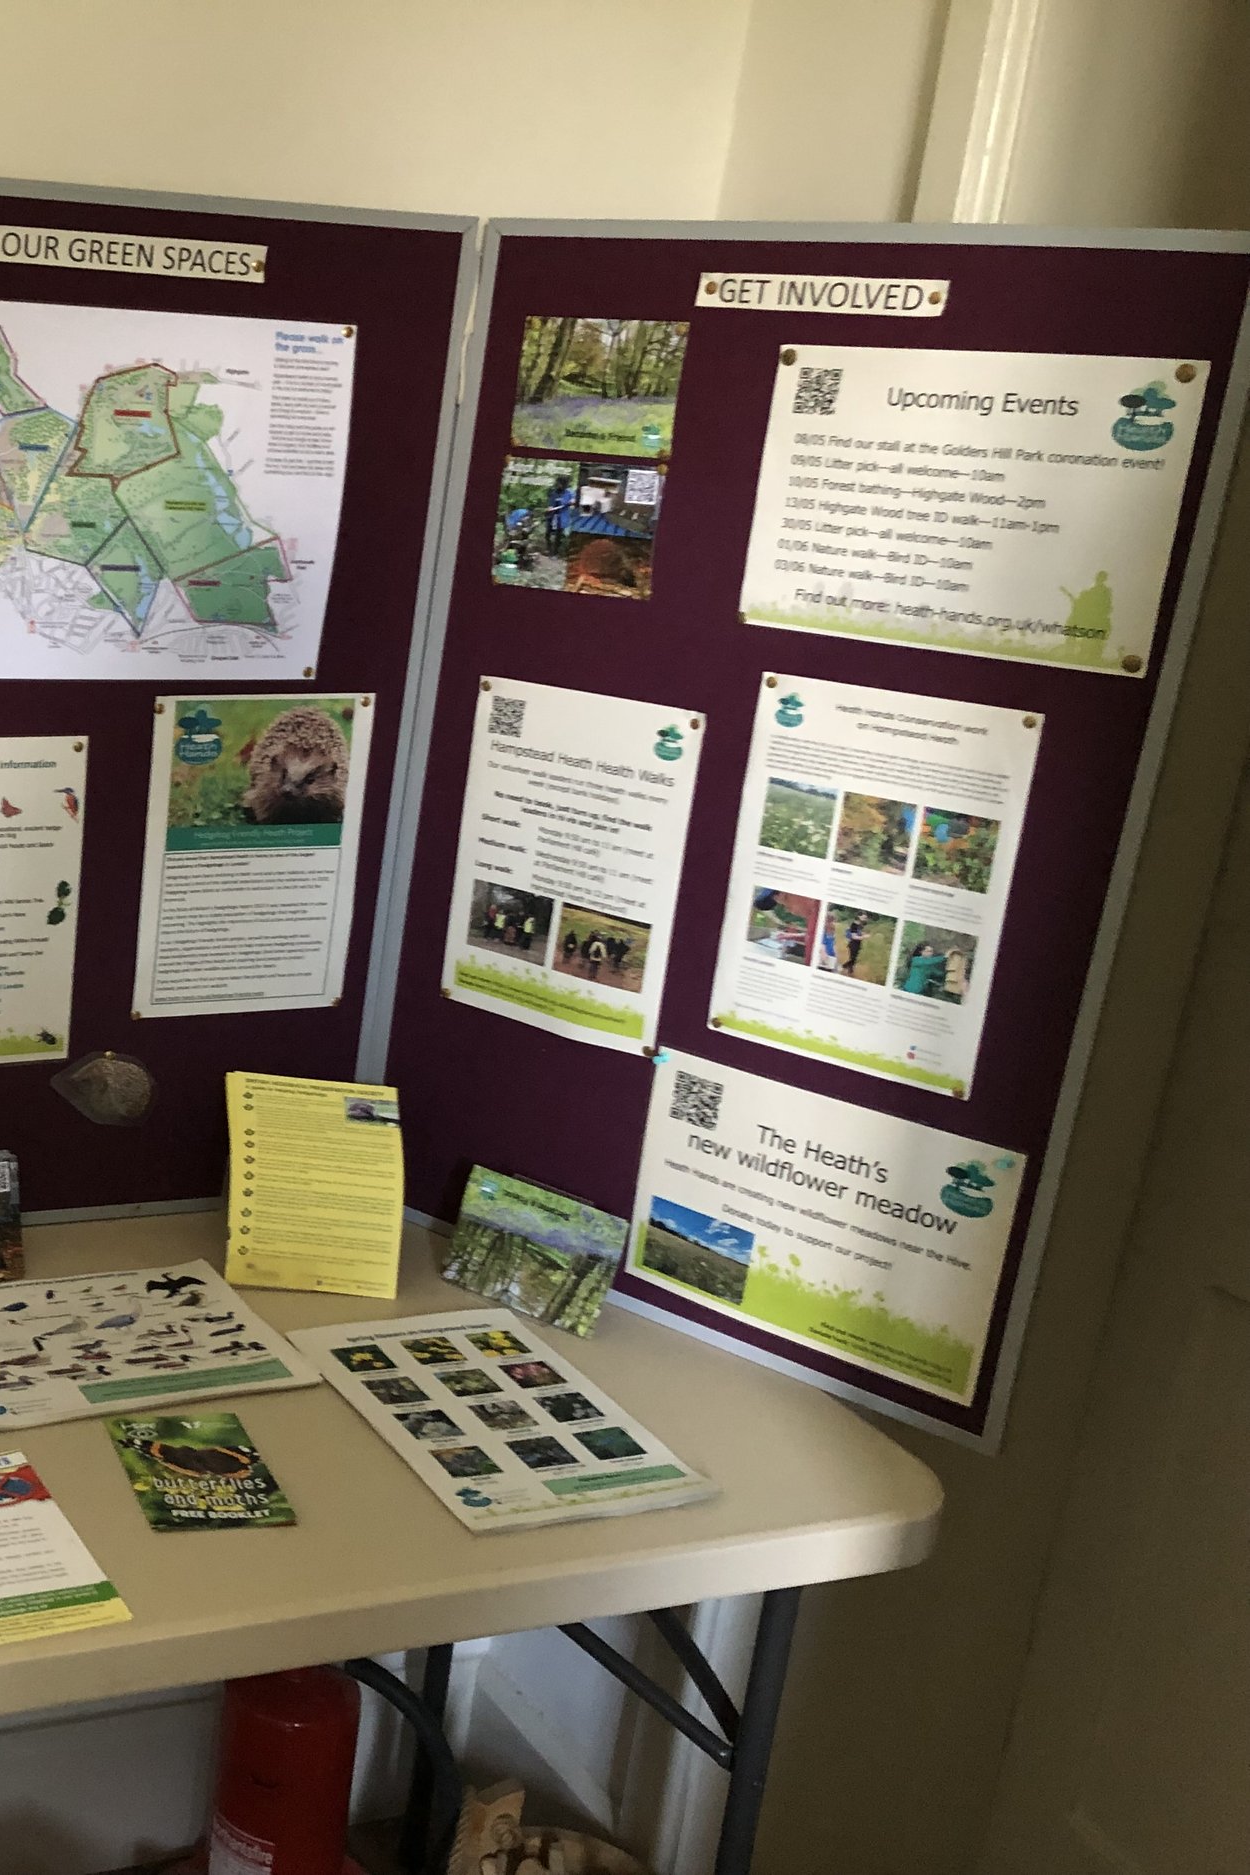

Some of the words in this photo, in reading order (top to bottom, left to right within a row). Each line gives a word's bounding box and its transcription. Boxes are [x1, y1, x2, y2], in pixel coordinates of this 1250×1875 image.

[1, 232, 60, 261] OUR
[68, 238, 154, 268] GREEN
[162, 246, 251, 276] SPACES
[718, 279, 771, 304] GET
[777, 280, 925, 311] INVOLVED
[887, 386, 994, 417] Upcoming
[1001, 392, 1080, 416] Events
[828, 435, 852, 448] Find
[854, 440, 875, 450] our
[903, 442, 917, 453] at
[918, 442, 939, 454] the
[1014, 448, 1044, 462] Park
[1047, 452, 1119, 467] coronation
[821, 478, 856, 492] Forest
[818, 499, 868, 516] Highgate
[870, 504, 905, 519] Wood
[811, 541, 848, 557] Nature
[808, 562, 845, 577] Nature
[794, 588, 824, 604] Find
[825, 593, 849, 608] out
[897, 713, 962, 730] Conservation
[489, 739, 555, 763] Hampstead
[557, 753, 594, 770] Heath
[595, 761, 636, 780] Health
[638, 768, 676, 788] Walks
[757, 1123, 797, 1154] The
[687, 1133, 732, 1160] new
[737, 1149, 849, 1200] wildflower
[855, 1190, 958, 1235] meadow
[721, 1203, 754, 1223] Donate
[755, 1216, 782, 1234] today
[796, 1230, 834, 1250] support
[737, 1185, 775, 1207] creating
[798, 1207, 848, 1229] wildflower
[850, 1223, 898, 1247] meadows
[153, 1476, 268, 1491] butterflies
[164, 1492, 198, 1506] and
[205, 1492, 270, 1507] moths
[171, 1509, 205, 1519] FREE
[207, 1509, 270, 1519] BOOKLET
